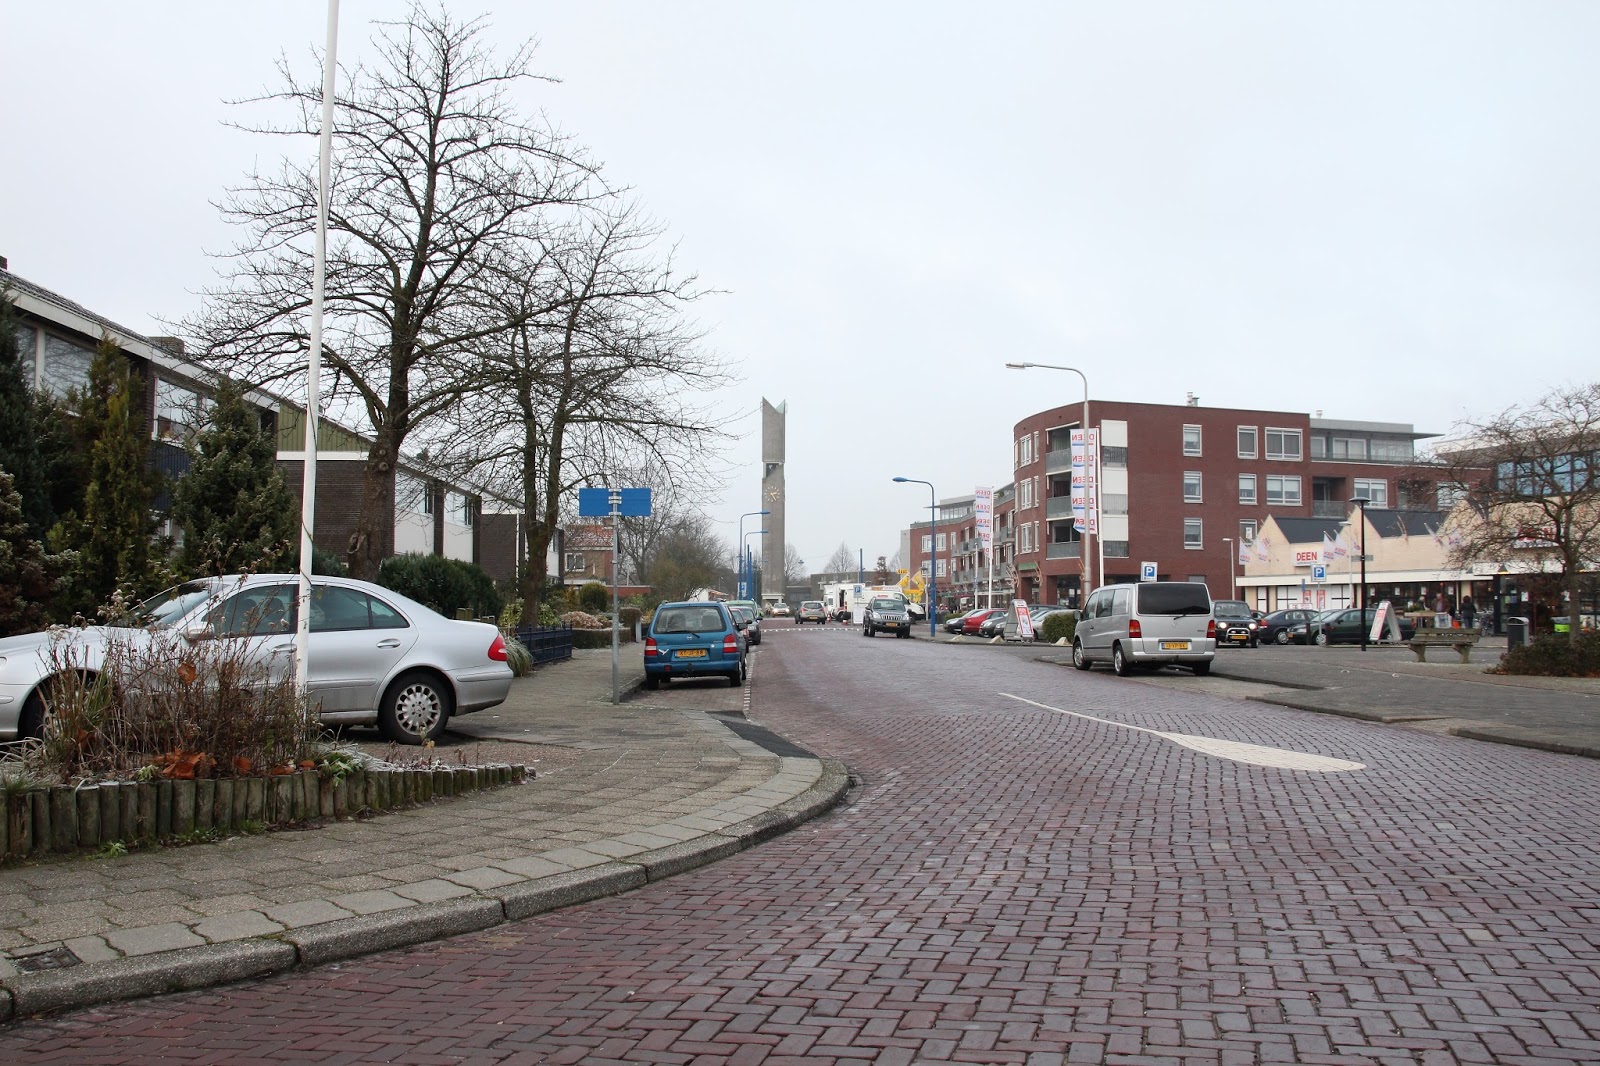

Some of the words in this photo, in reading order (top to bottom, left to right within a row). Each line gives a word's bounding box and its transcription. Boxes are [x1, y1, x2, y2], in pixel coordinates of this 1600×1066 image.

[1296, 551, 1318, 561] DEEN
[1146, 567, 1153, 576] P
[1315, 567, 1323, 577] P
